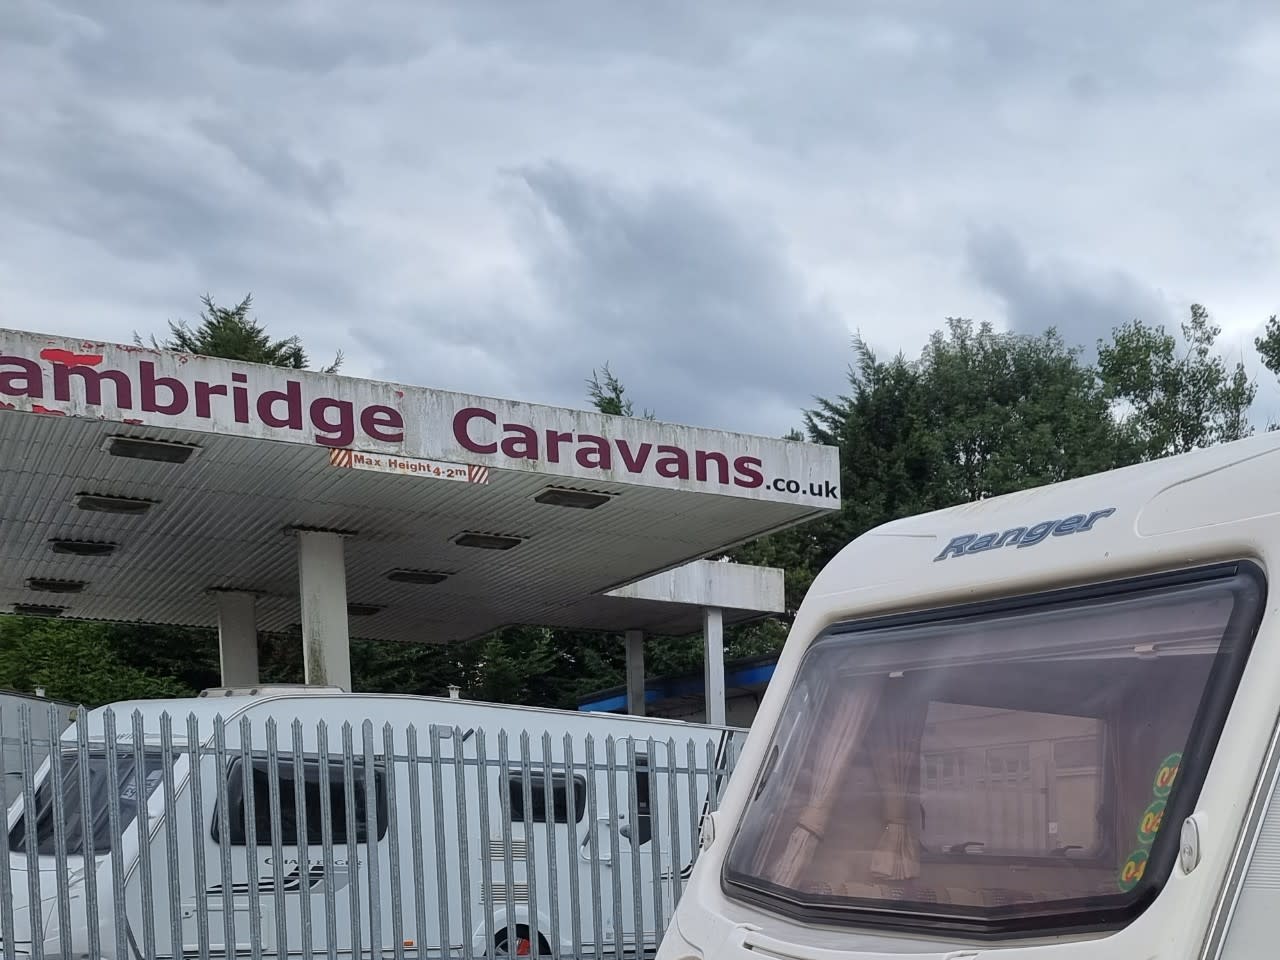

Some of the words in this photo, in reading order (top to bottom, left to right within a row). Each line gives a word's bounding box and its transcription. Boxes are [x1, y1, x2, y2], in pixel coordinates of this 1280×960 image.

[0, 354, 404, 447] ambridge
[452, 407, 764, 489] Caravans
[354, 454, 382, 467] Max
[388, 458, 431, 473] Height
[933, 507, 1117, 562] Ranger
